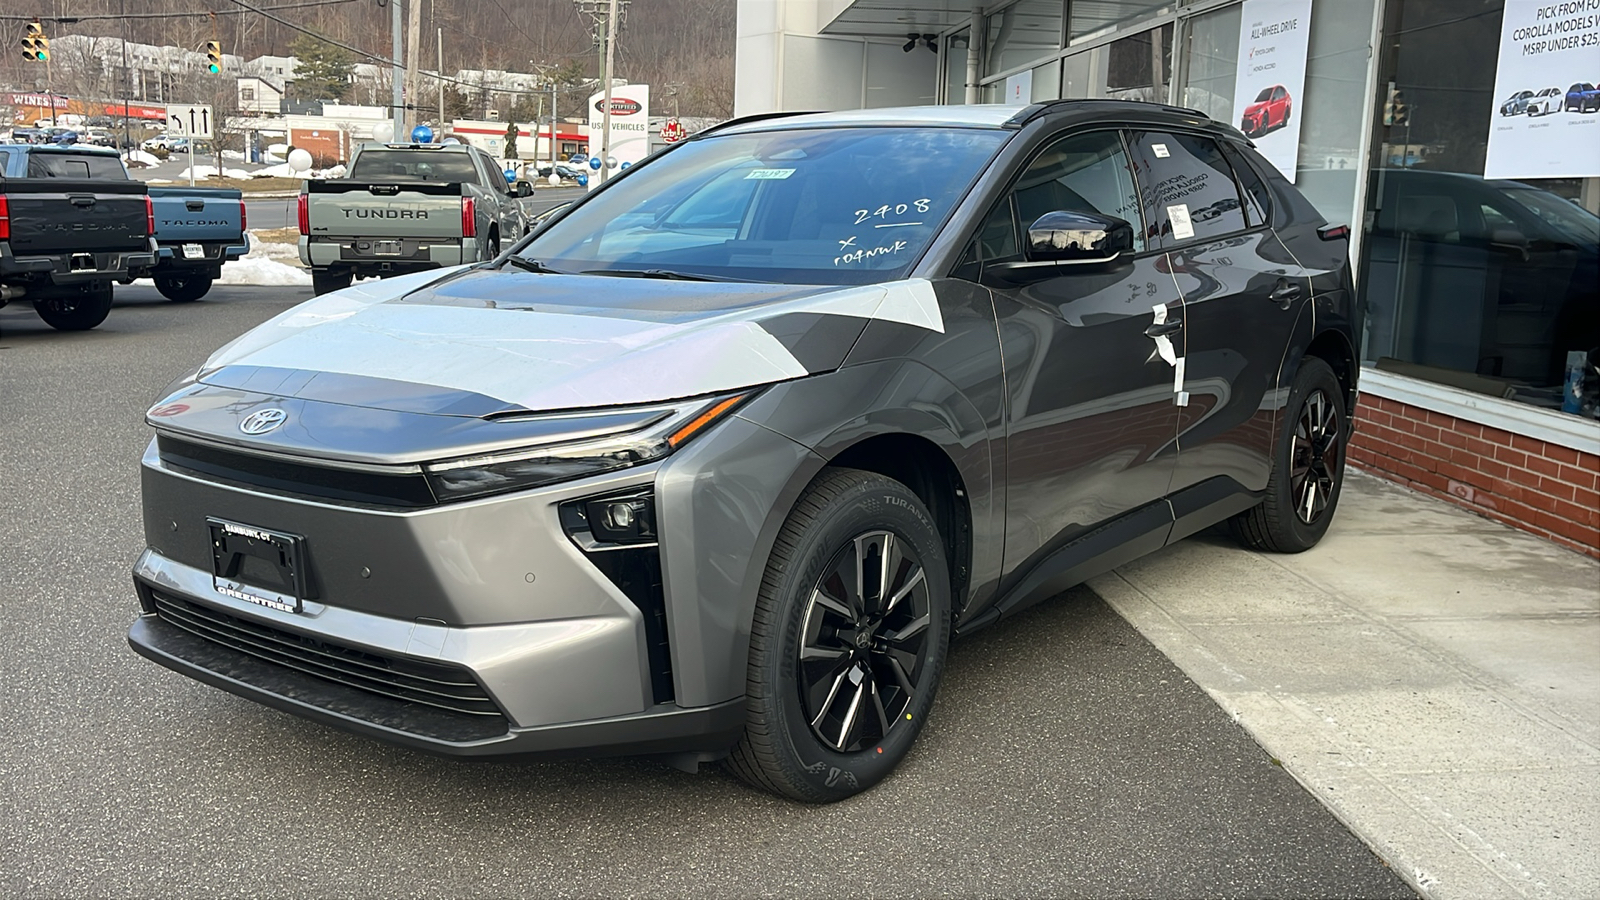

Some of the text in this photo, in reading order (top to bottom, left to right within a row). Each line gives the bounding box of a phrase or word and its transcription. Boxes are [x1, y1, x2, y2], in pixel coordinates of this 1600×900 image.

[1537, 5, 1557, 20] PICK
[1558, 0, 1585, 16] FROM
[1250, 24, 1279, 40] ALL-WHEEL
[1280, 19, 1297, 33] DRIVE
[1513, 23, 1553, 41] COROLLA
[1554, 15, 1593, 34] MODELS
[1522, 41, 1547, 56] MSRP
[1548, 35, 1579, 52] UNDER
[12, 94, 49, 108] WINES
[612, 122, 645, 132] VEHICLES
[341, 208, 429, 219] TUNDRA
[854, 198, 931, 225] 2408
[37, 223, 130, 231] TACOMA
[883, 495, 935, 536] TURANZA
[217, 586, 294, 613] GREENTREE
[780, 533, 834, 679] BRIDGESTONE
